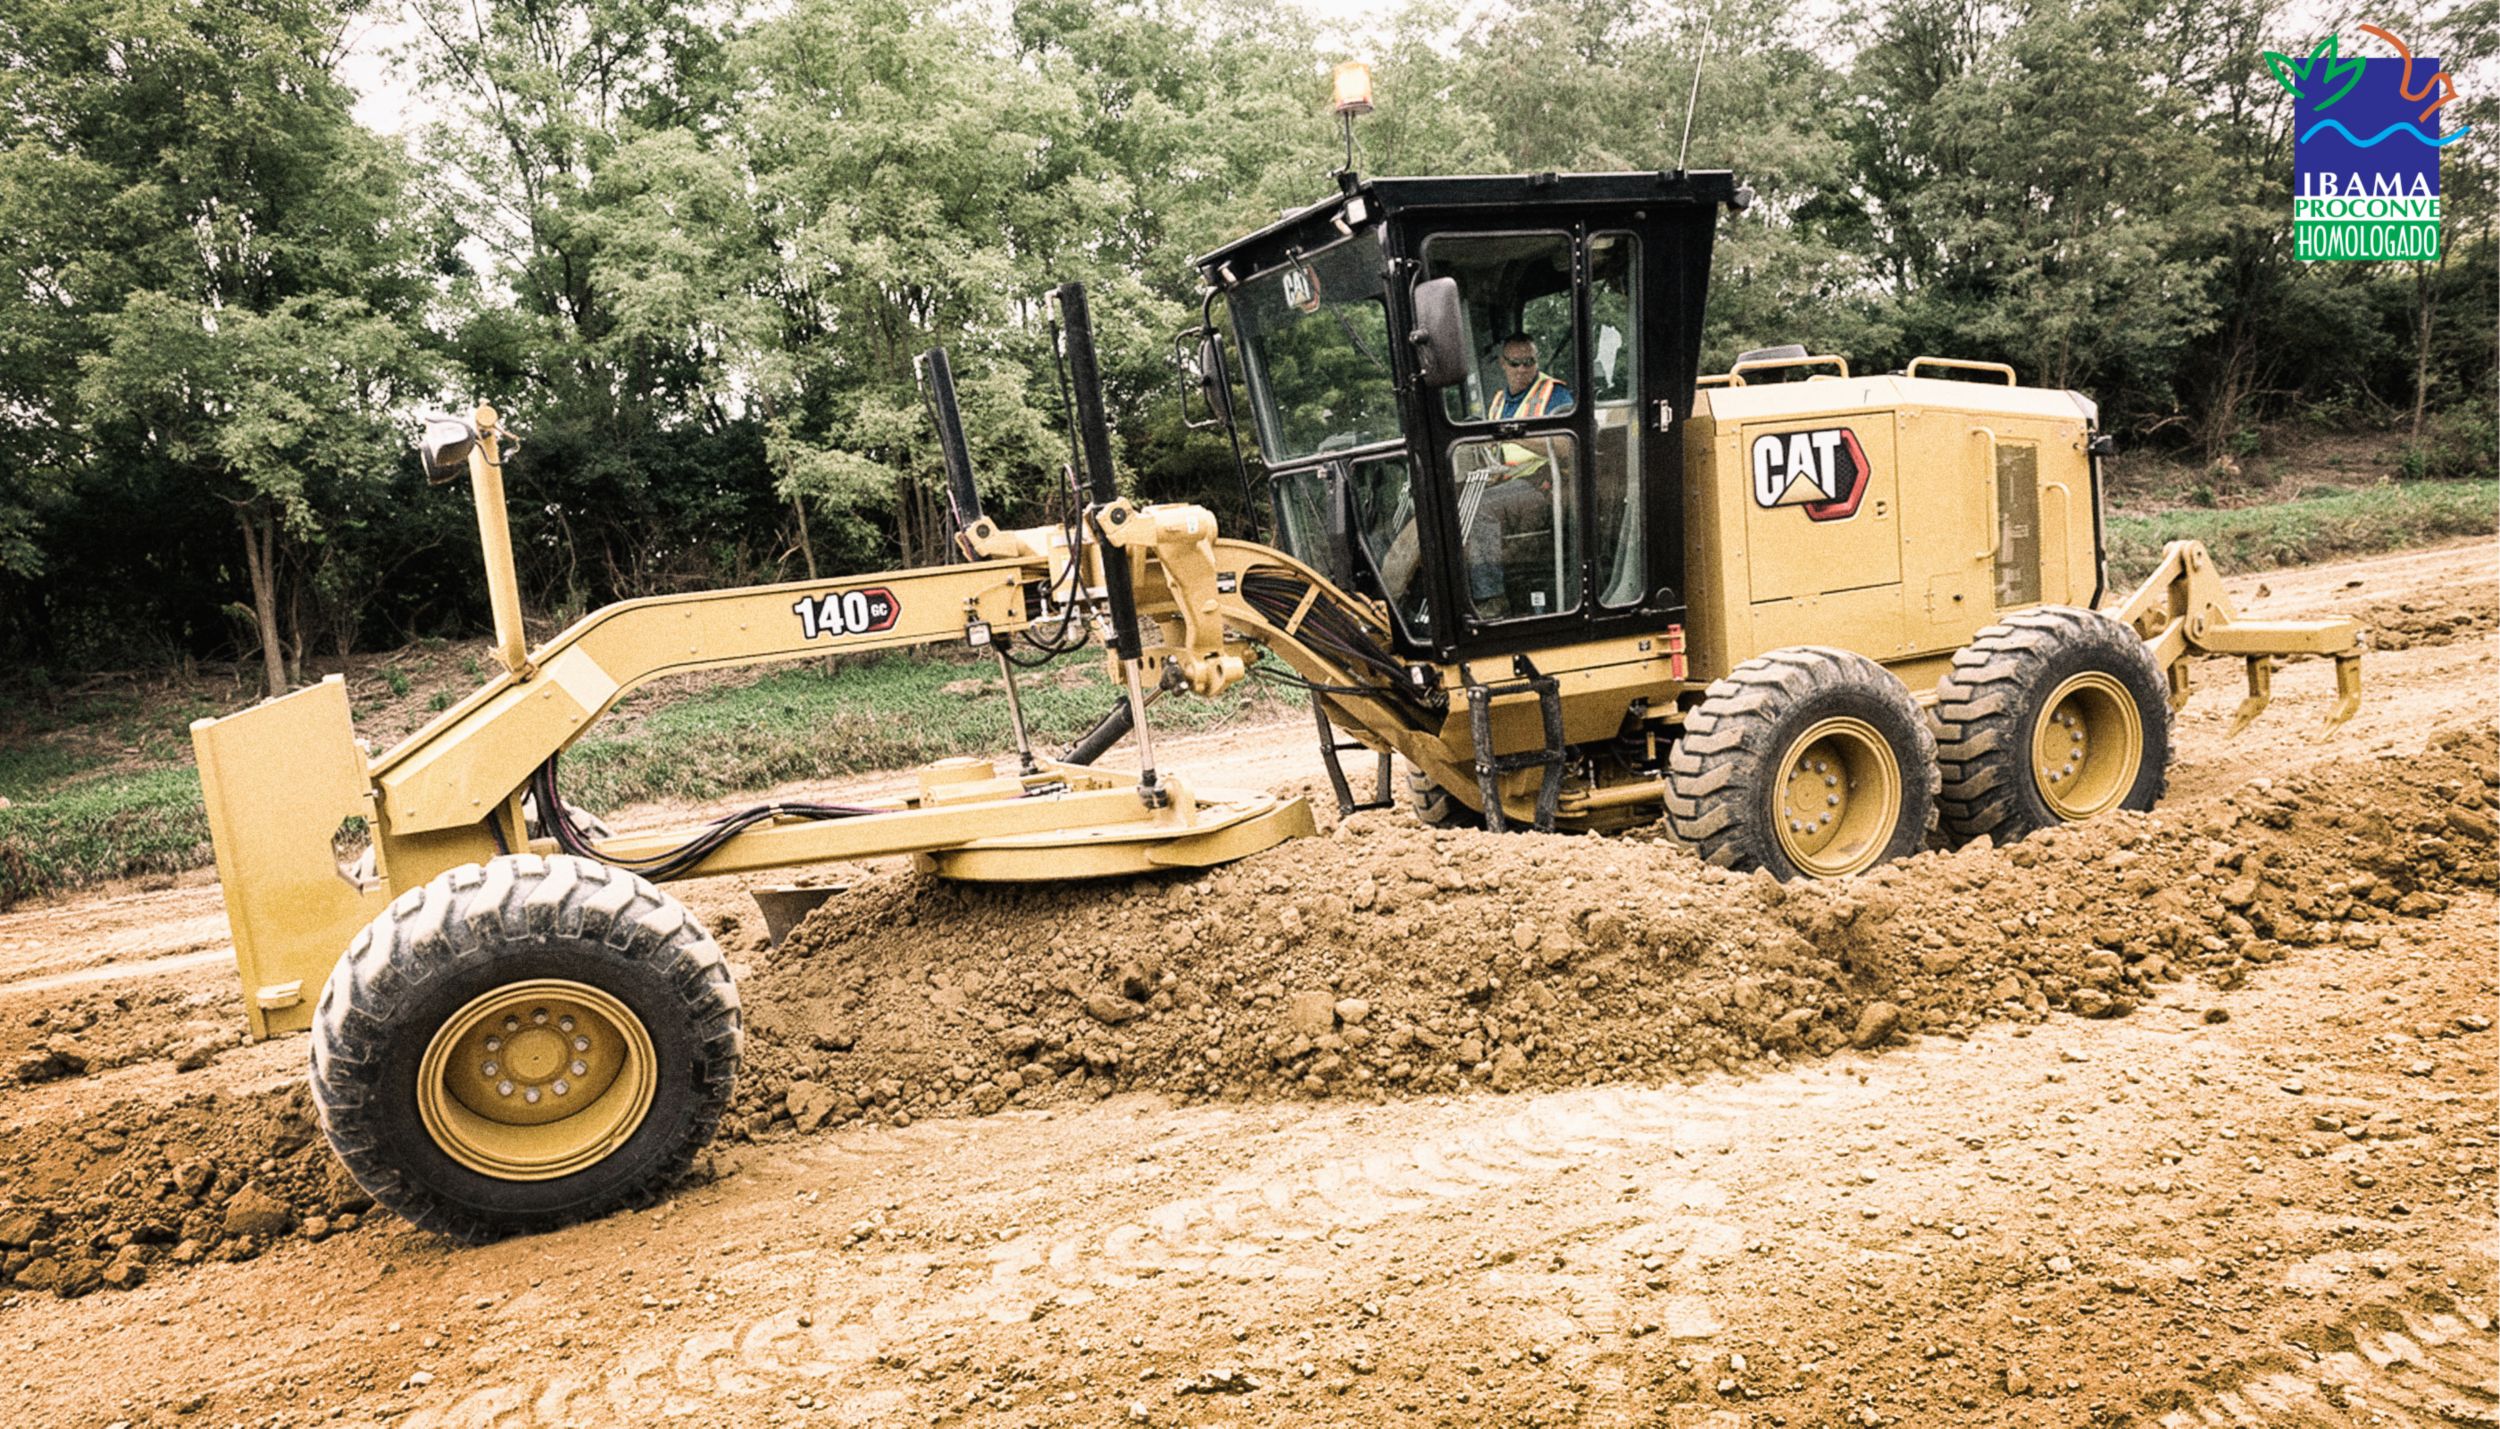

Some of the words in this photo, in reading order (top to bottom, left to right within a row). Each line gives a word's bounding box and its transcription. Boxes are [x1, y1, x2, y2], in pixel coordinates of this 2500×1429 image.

[1282, 267, 1311, 308] CAT
[1753, 429, 1842, 507] CAT
[794, 591, 870, 638] 140
[870, 603, 888, 617] GC
